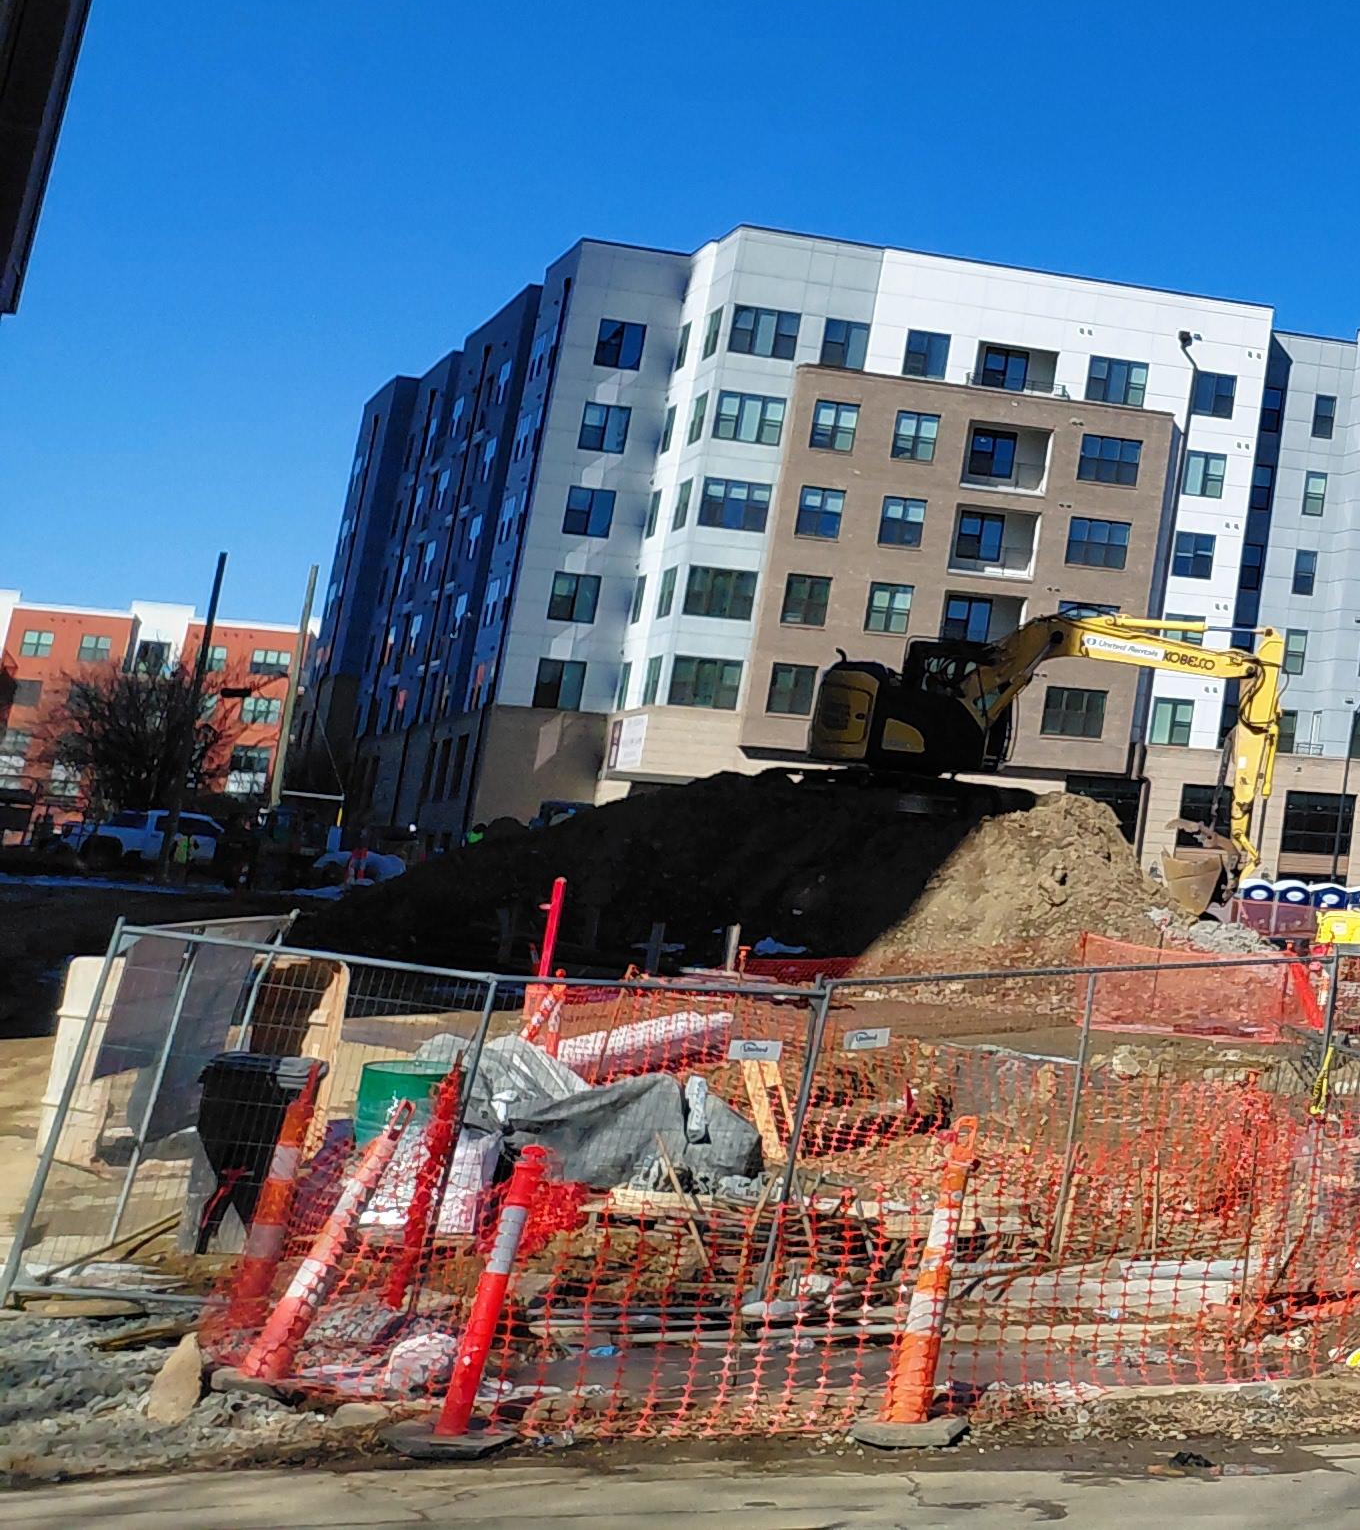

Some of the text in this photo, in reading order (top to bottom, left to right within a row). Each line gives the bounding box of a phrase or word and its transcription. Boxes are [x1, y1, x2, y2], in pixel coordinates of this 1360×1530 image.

[1098, 640, 1159, 657] United Rentals
[1162, 650, 1215, 671] KOBELCO
